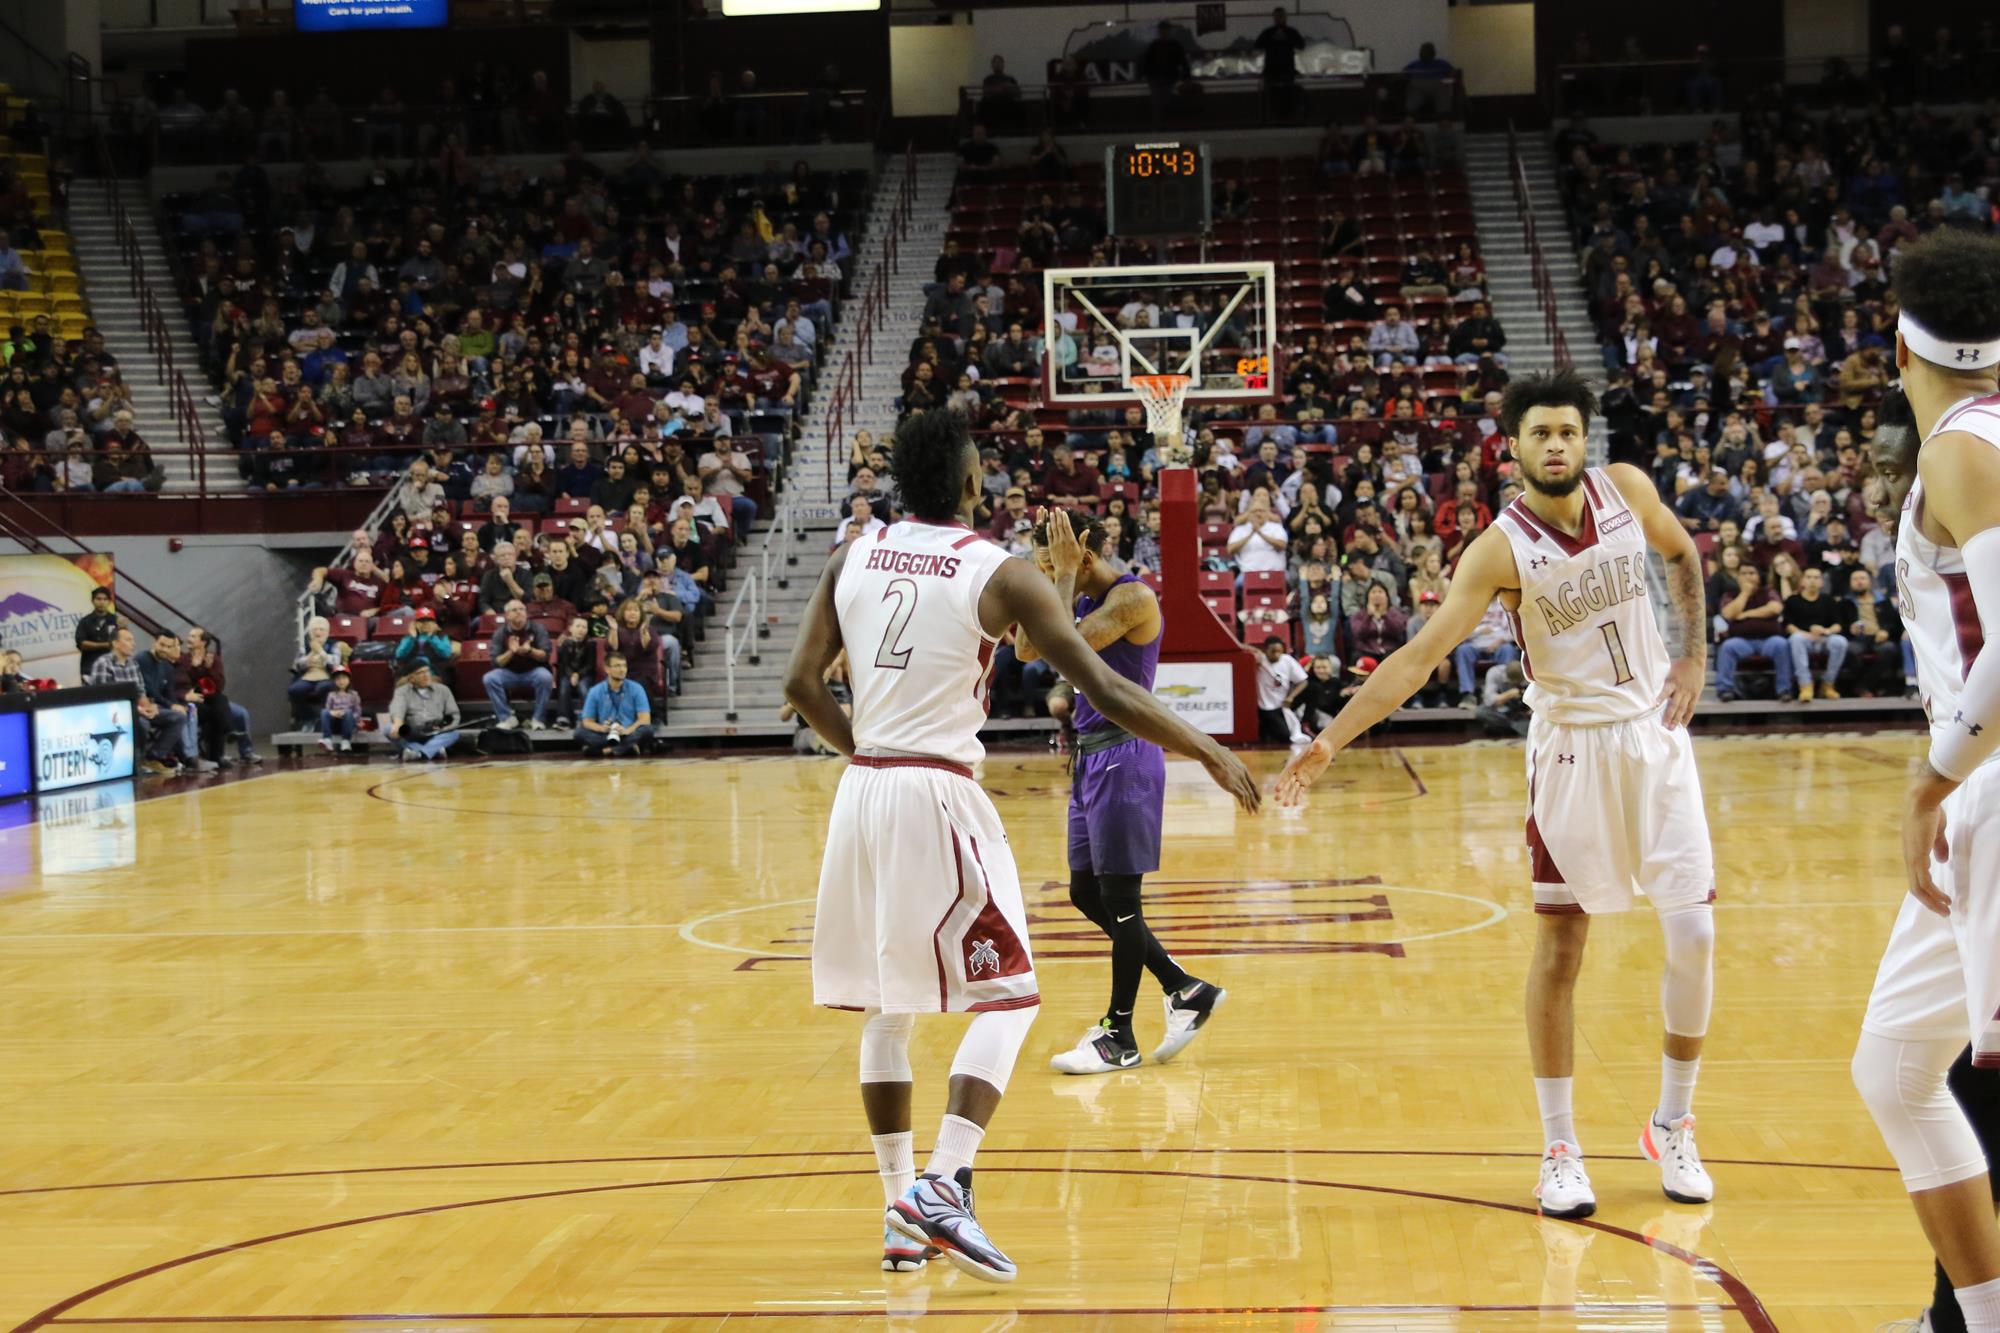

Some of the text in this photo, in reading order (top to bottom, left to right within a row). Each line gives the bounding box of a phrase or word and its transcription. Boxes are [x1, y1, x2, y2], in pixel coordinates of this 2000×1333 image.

[1129, 151, 1195, 177] 10:43
[1599, 511, 1631, 533] WAC
[865, 548, 961, 579] HUGGINS
[1536, 551, 1647, 637] AGGIES
[873, 577, 919, 671] 2
[1597, 620, 1635, 687] 1
[1176, 701, 1229, 712] DEALERS
